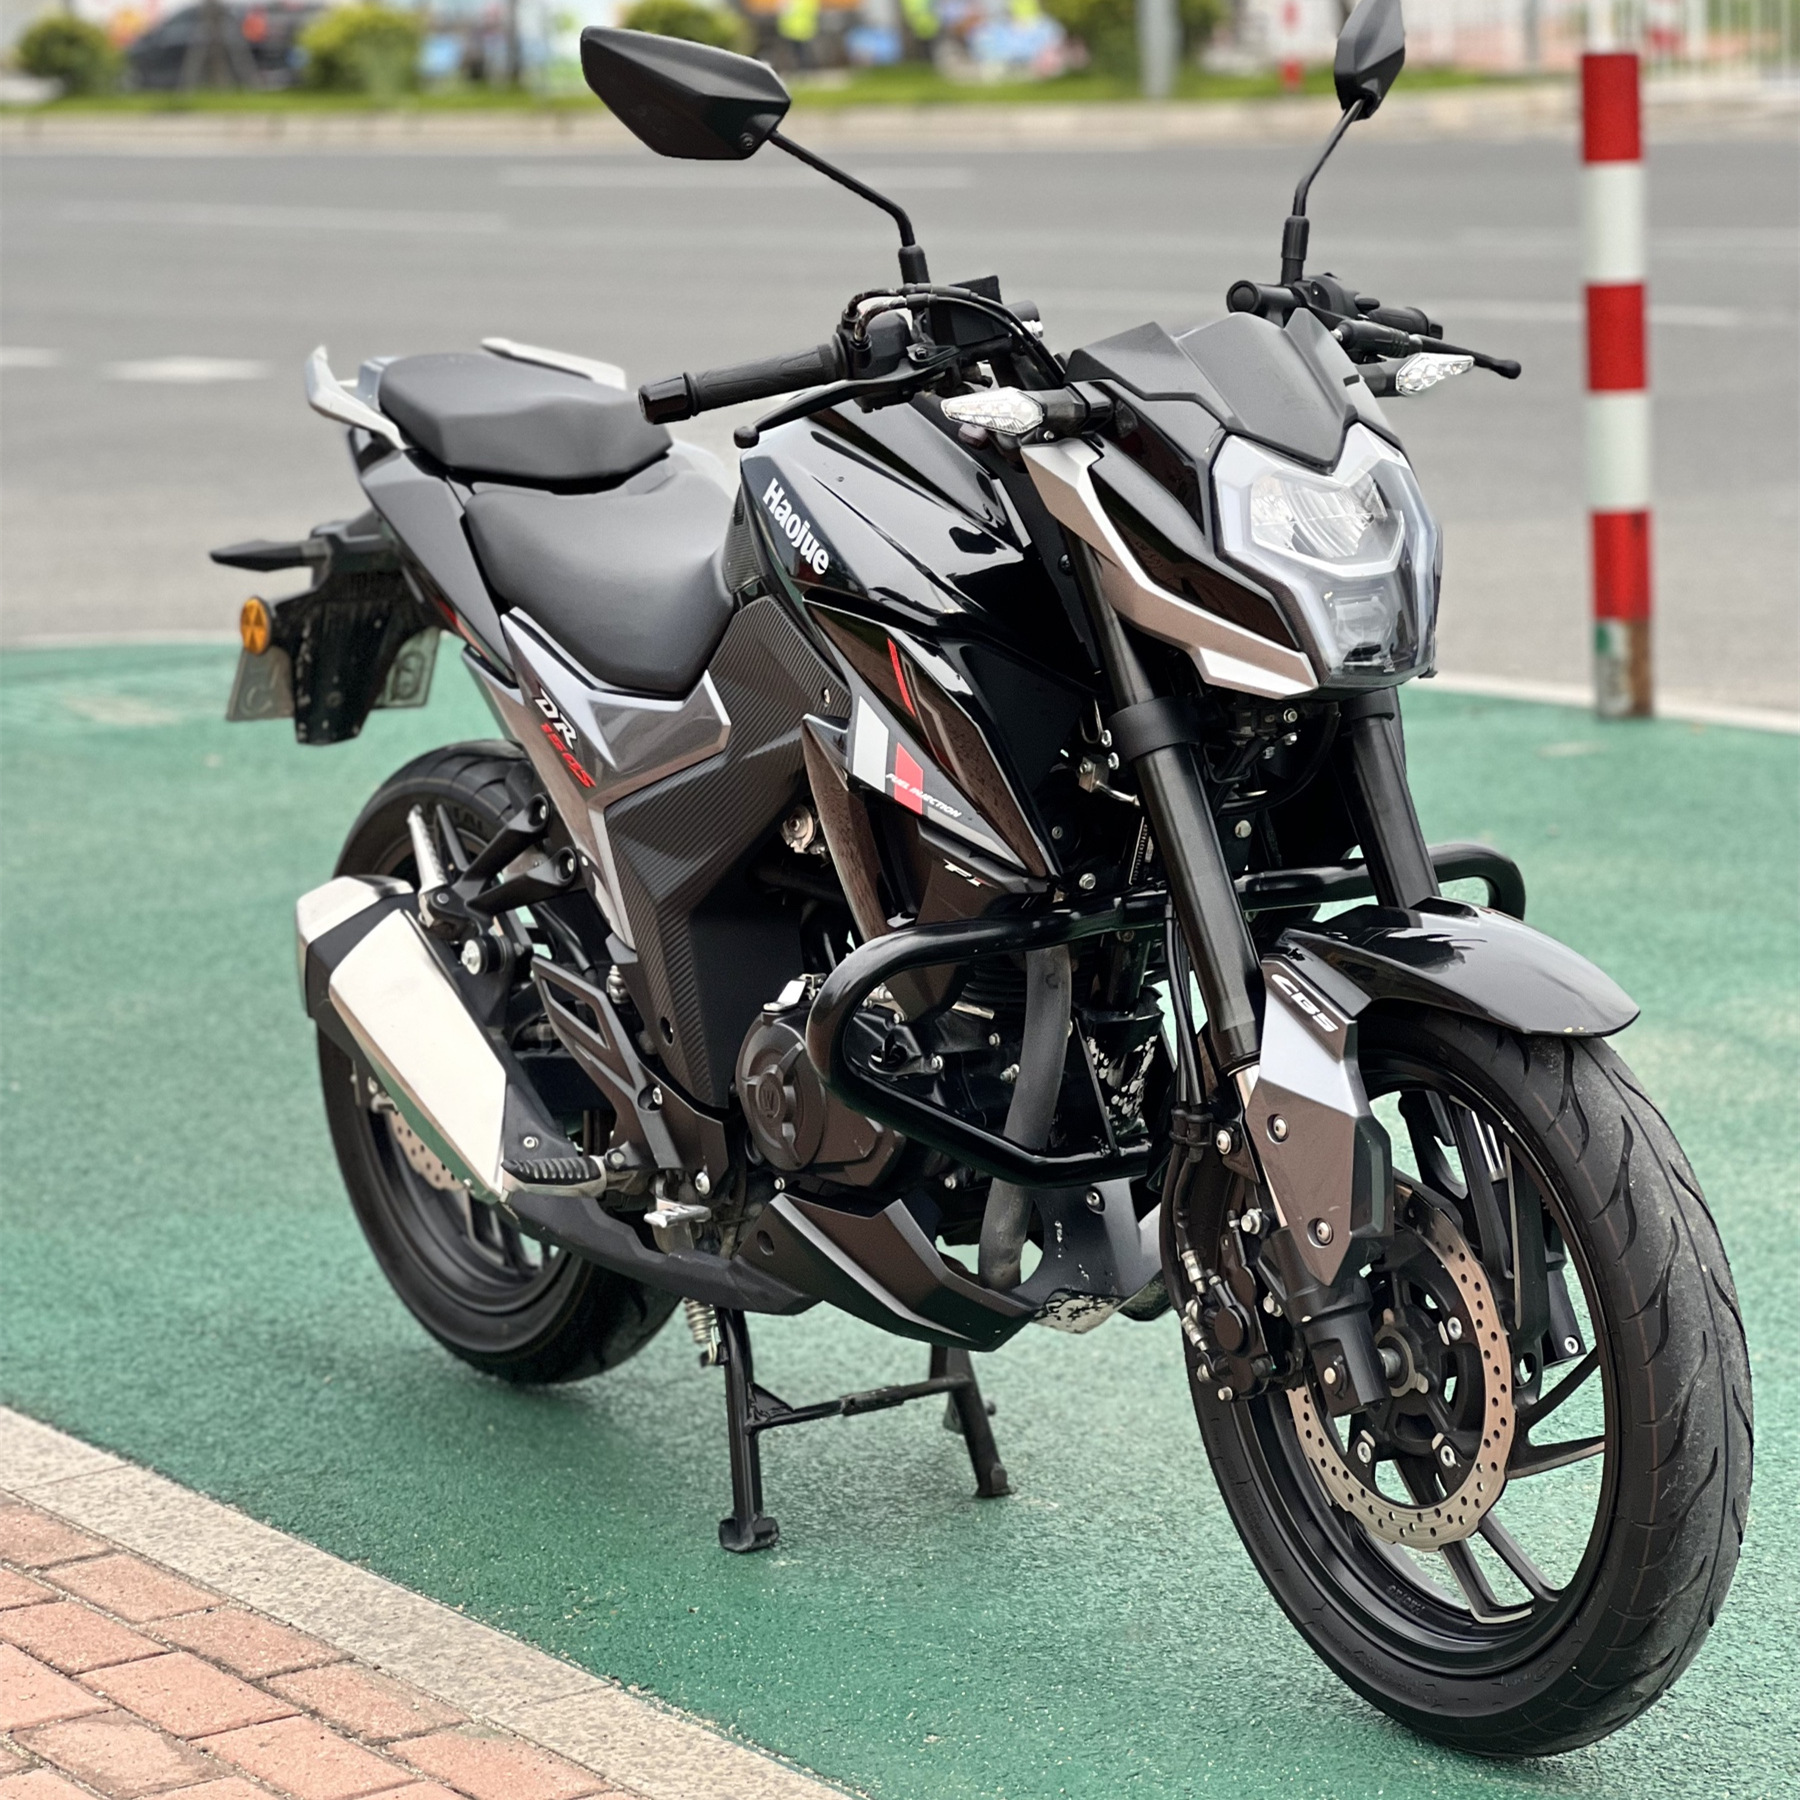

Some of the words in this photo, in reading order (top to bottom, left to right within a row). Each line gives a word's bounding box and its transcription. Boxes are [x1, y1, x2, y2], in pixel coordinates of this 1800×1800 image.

[762, 477, 829, 575] Haojue
[534, 686, 577, 751] DR
[885, 772, 910, 790] FUEL
[908, 786, 963, 818] INJECTION
[1271, 973, 1339, 1032] CBS
